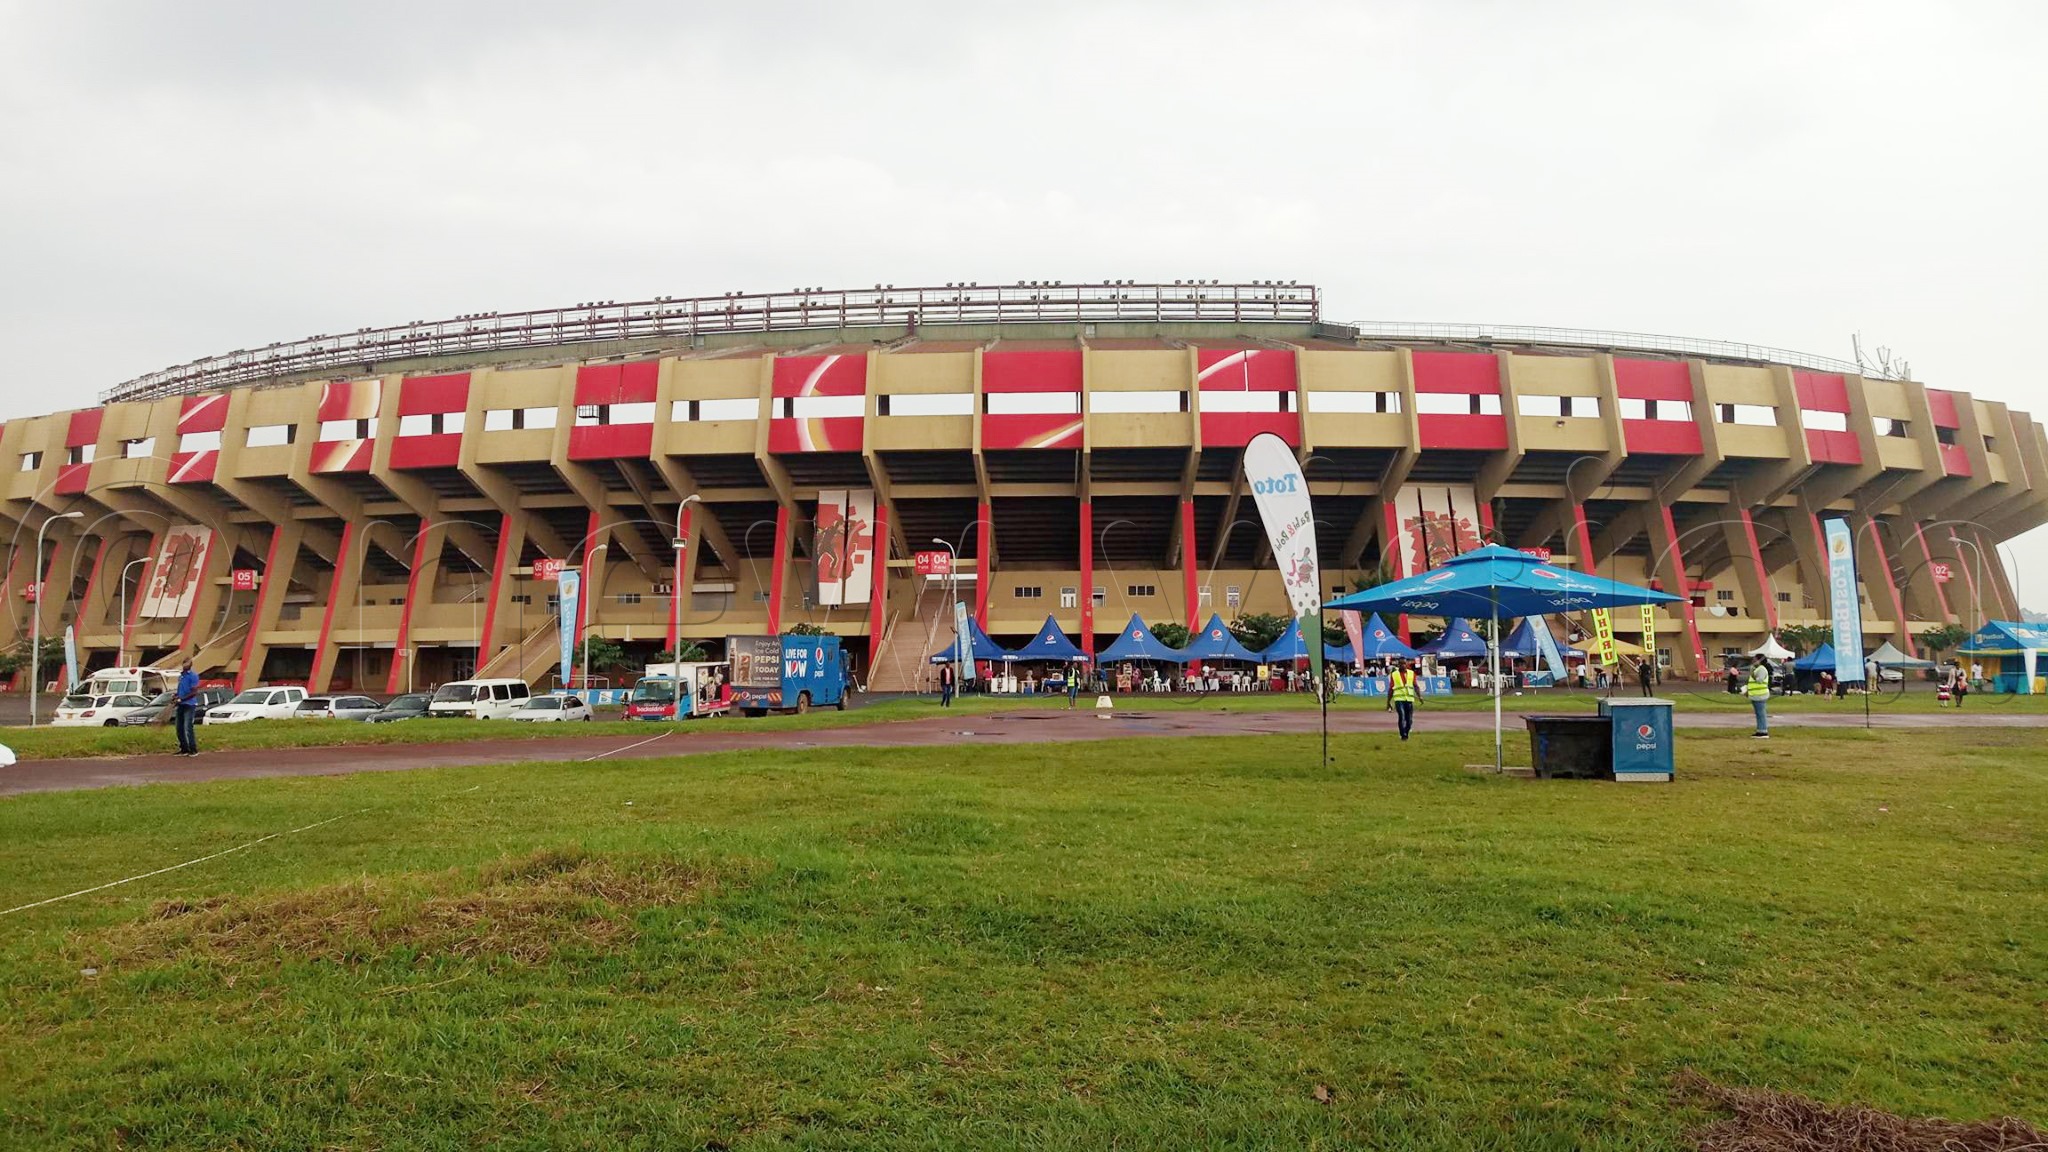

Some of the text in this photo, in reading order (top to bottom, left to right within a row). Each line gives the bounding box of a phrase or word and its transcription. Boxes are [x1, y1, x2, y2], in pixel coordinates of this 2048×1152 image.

[917, 554, 947, 565] 04 04
[545, 562, 560, 571] 04
[1935, 566, 1946, 574] 02
[237, 572, 251, 581] 05
[785, 649, 808, 659] LIVE FOR
[754, 656, 780, 664] PEPSI
[785, 661, 807, 678] NOW
